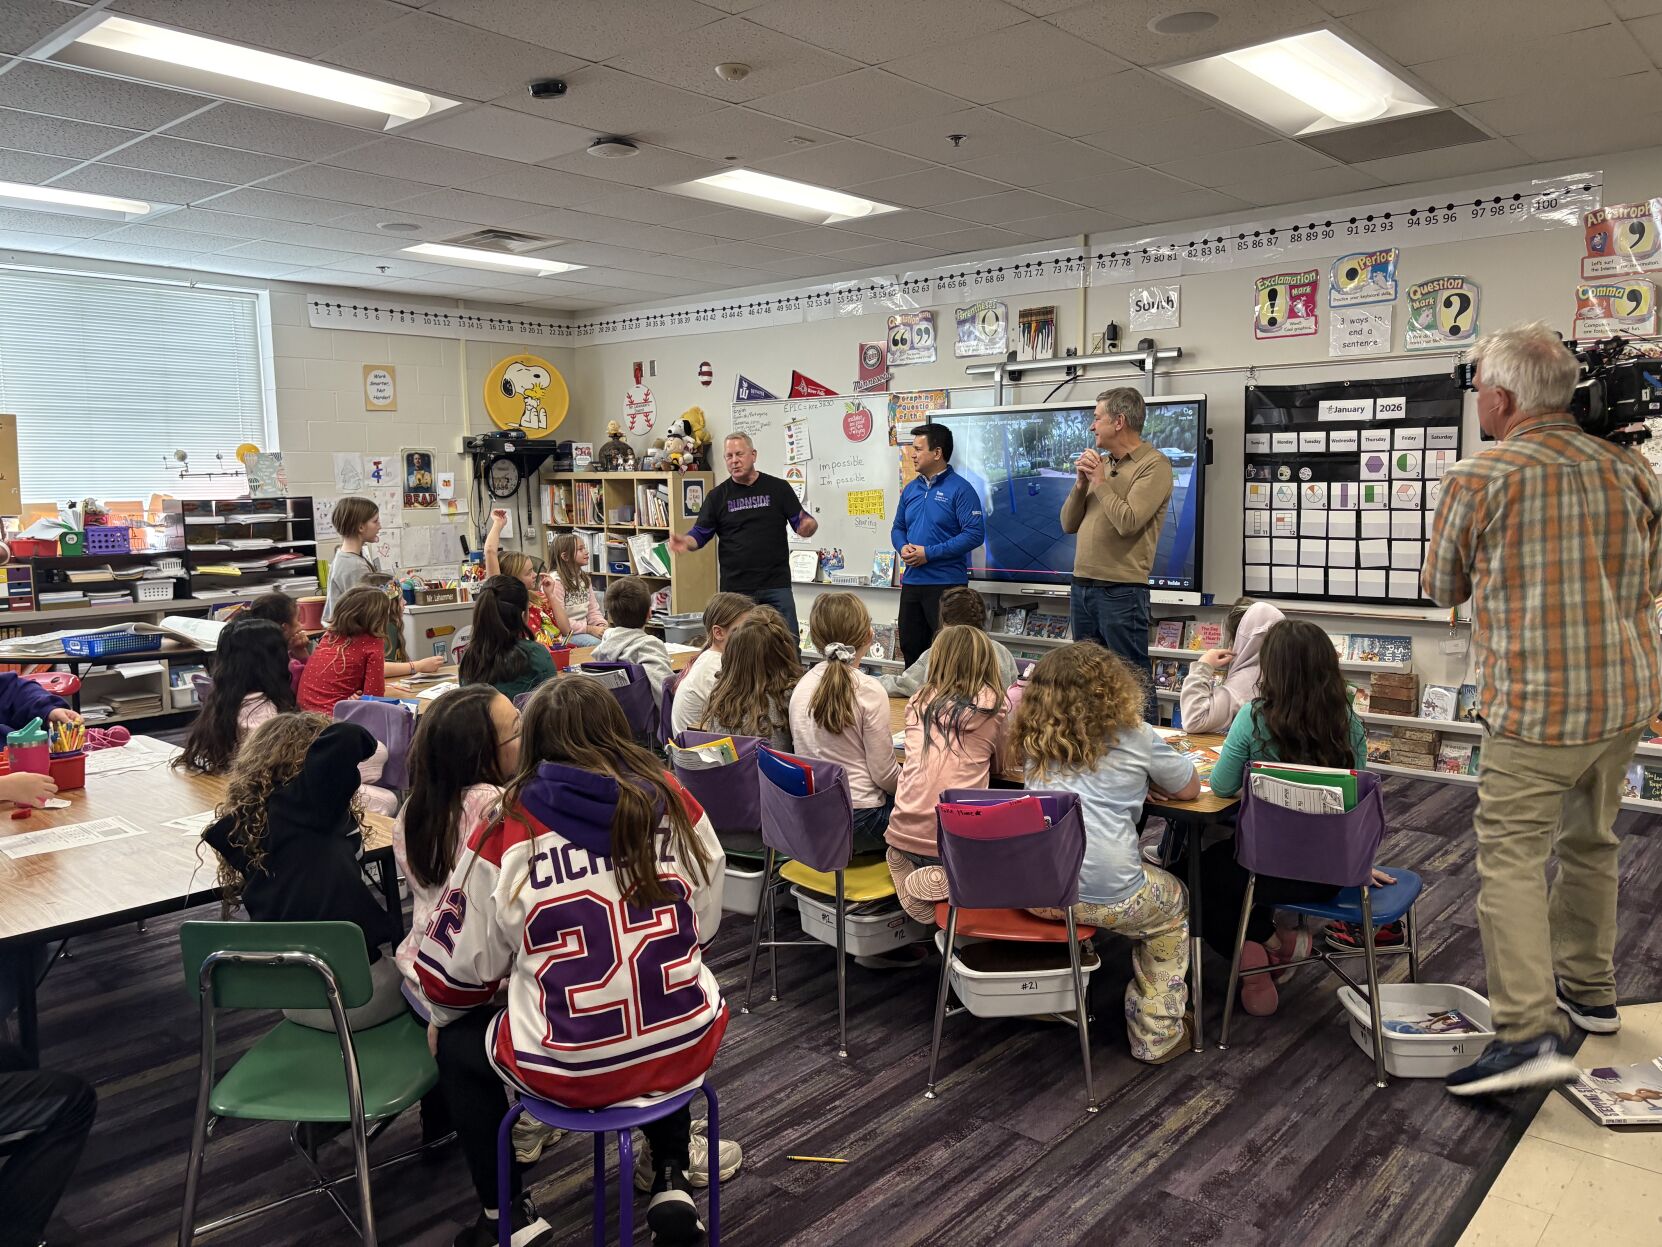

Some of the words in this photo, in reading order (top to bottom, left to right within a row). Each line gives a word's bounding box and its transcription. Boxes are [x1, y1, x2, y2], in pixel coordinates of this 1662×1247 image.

[1076, 263, 1085, 271] 75
[1097, 261, 1106, 269] 76
[1109, 259, 1118, 268] 77
[1121, 258, 1131, 266] 78
[1141, 255, 1150, 264] 79
[1154, 254, 1164, 262] 80
[1167, 252, 1177, 261] 81
[1188, 248, 1198, 257] 82
[1201, 246, 1212, 256] 83
[1215, 245, 1225, 254] 84
[1237, 240, 1248, 250] 85
[1252, 238, 1263, 248] 86
[1267, 237, 1278, 246] 87
[1290, 232, 1302, 242] 88
[1306, 231, 1318, 241] 89
[1322, 229, 1334, 239] 90
[1347, 225, 1359, 235] 91
[1363, 223, 1376, 234] 92
[1380, 222, 1393, 232] 93
[1408, 217, 1420, 227] 94
[1425, 215, 1438, 226] 95
[1443, 212, 1457, 223] 96
[1472, 208, 1486, 219] 97
[1490, 206, 1504, 217] 98
[1509, 203, 1523, 214] 99
[1536, 198, 1558, 210] 100
[1359, 250, 1394, 269] Period
[1256, 272, 1316, 290] Exclamation
[1410, 278, 1462, 300] Question
[1291, 286, 1311, 296] Mark
[1579, 286, 1624, 299] Comma
[1135, 296, 1174, 312] South
[1412, 298, 1434, 309] Mark
[784, 404, 802, 412] EPIC
[1333, 404, 1365, 414] January
[1380, 403, 1402, 412] 2026
[836, 476, 865, 488] possible
[405, 494, 437, 506] READ
[1384, 645, 1394, 662] Pup
[528, 828, 676, 890] CICHZ
[426, 886, 467, 958] 2
[524, 872, 712, 1051] 22
[1021, 982, 1038, 990] #21
